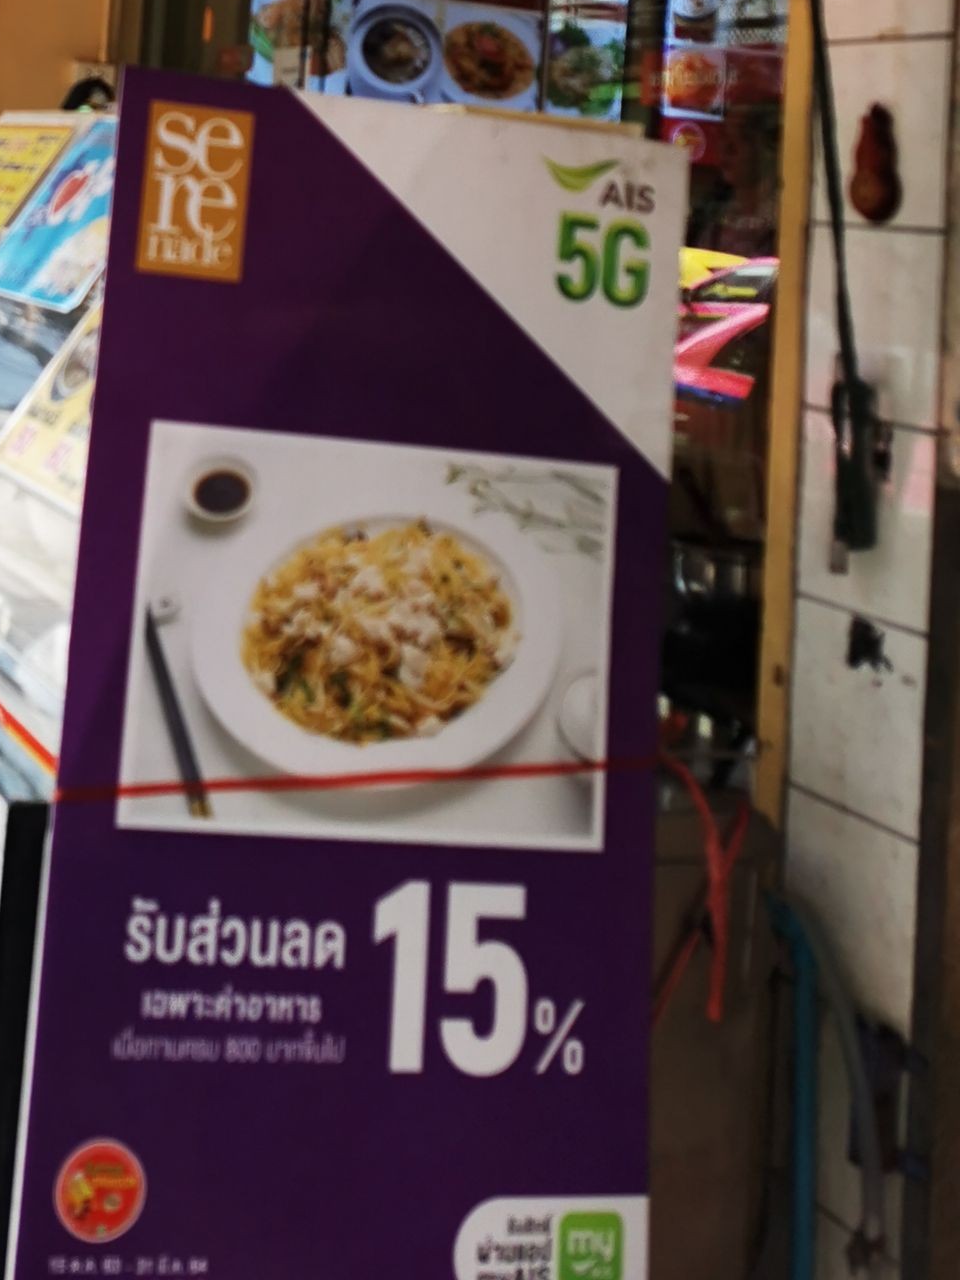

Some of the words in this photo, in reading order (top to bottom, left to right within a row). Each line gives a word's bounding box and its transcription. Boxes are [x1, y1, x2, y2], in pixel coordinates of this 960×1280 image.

[599, 180, 656, 214] AIS
[555, 210, 651, 310] 5G
[124, 896, 347, 970] รับส่วนลด
[567, 1227, 615, 1263] my
